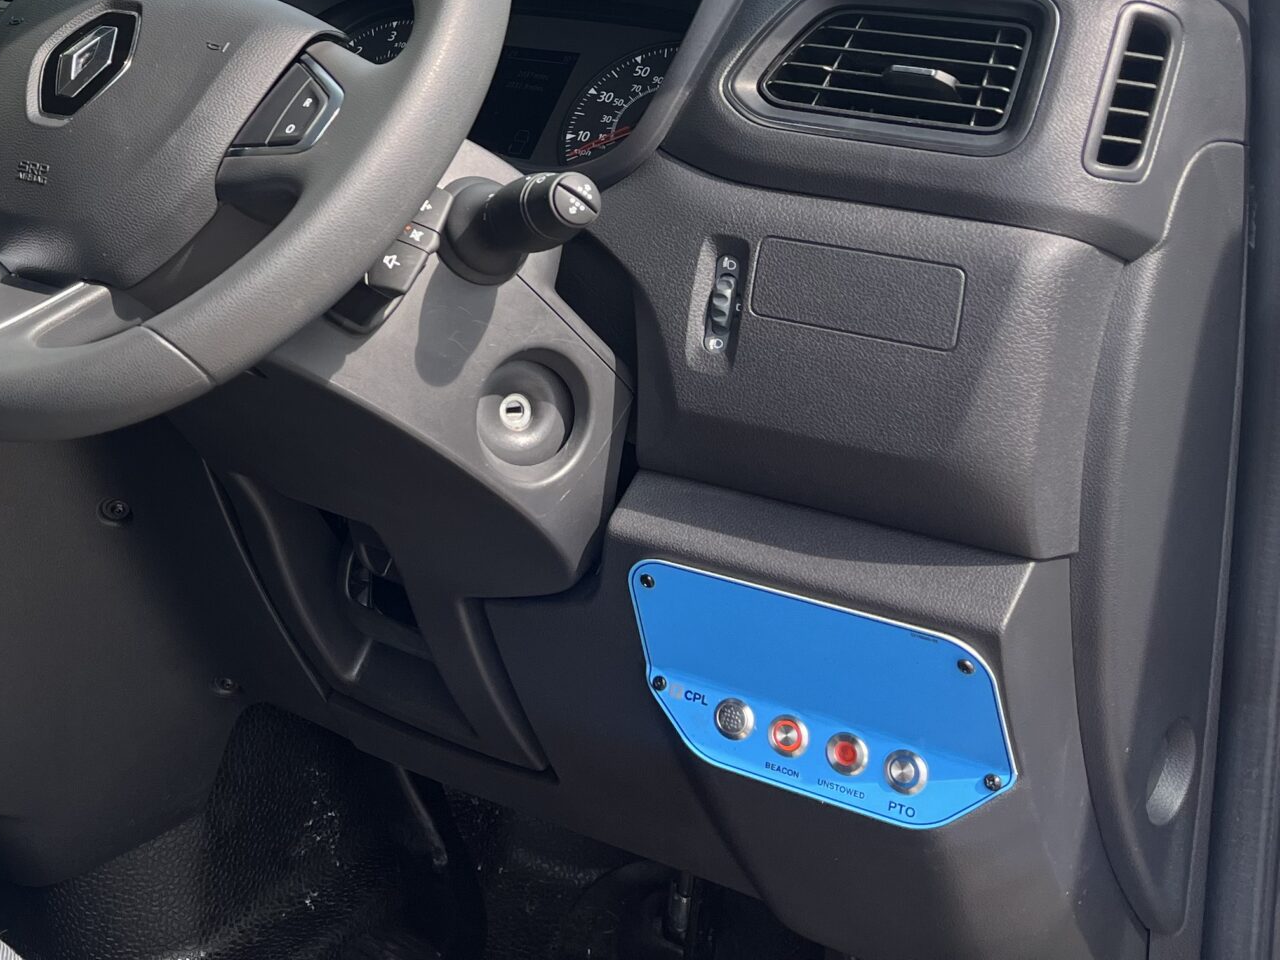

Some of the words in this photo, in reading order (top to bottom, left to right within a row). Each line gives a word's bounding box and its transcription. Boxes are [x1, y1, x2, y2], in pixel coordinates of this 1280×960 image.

[387, 31, 397, 42] 3
[633, 65, 651, 78] 50
[652, 76, 664, 85] 90
[630, 85, 642, 93] 70
[302, 97, 313, 108] R
[596, 91, 614, 104] 30
[612, 98, 624, 107] 50
[600, 115, 613, 124] 30
[576, 131, 591, 143] 10
[18, 160, 50, 176] SRP
[684, 690, 708, 706] CPL
[765, 762, 800, 779] BEACON
[817, 778, 866, 800] UNSTOWED
[888, 801, 916, 818] PTO
